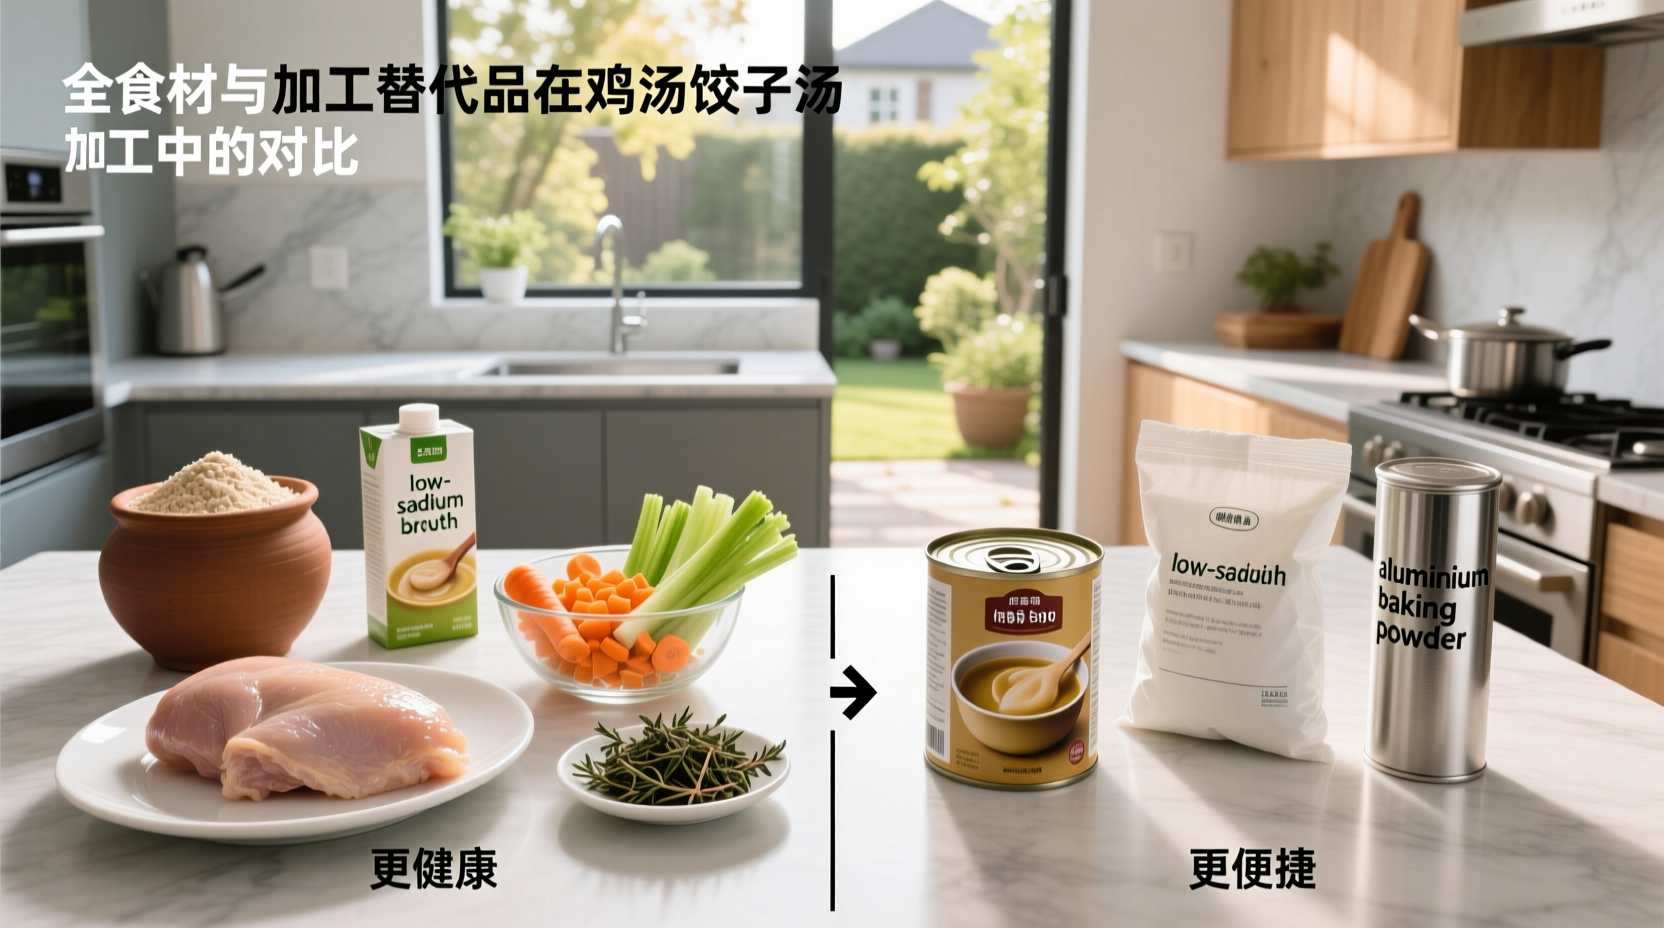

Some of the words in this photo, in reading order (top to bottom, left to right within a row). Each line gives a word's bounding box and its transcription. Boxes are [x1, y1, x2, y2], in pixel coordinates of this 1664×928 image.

[410, 474, 451, 492] low-
[397, 493, 464, 514] sadium
[1379, 557, 1489, 589] aluminium
[1378, 585, 1457, 627] baking
[1376, 620, 1467, 650] powder
